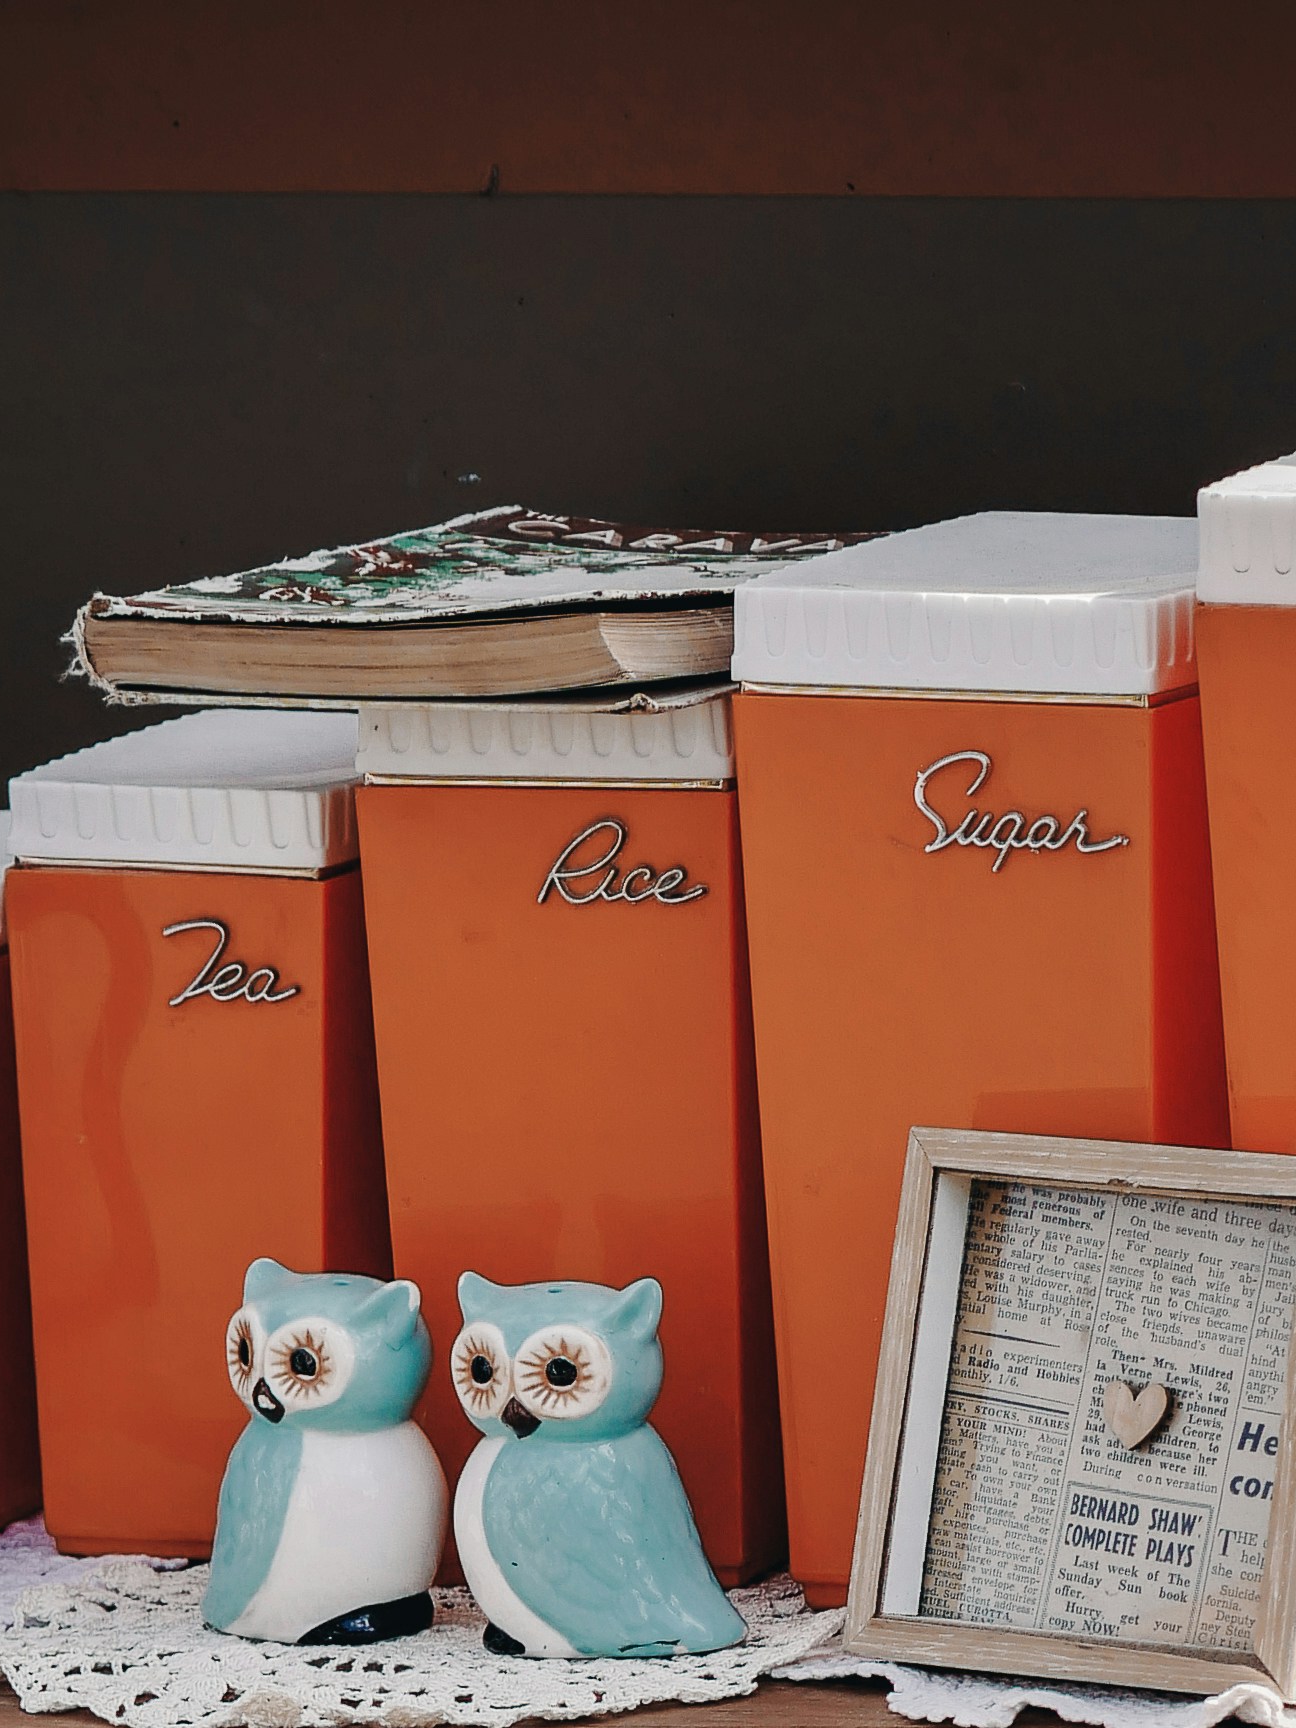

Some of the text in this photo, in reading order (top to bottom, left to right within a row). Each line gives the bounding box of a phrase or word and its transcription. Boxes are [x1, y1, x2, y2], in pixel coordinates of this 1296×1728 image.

[912, 748, 1130, 873] Sugar
[536, 817, 710, 906] Rice
[161, 918, 301, 1009] Tea
[991, 1204, 1034, 1220] Federal
[1031, 1200, 1081, 1216] generous
[1093, 1210, 1106, 1220] of
[1057, 1192, 1106, 1209] probably
[1121, 1191, 1149, 1210] one
[1190, 1207, 1218, 1223] and
[1225, 1210, 1262, 1230] three
[984, 1231, 1016, 1245] whole
[1022, 1238, 1035, 1248] of
[1040, 1240, 1058, 1253] his
[1044, 1231, 1072, 1242] gave
[1075, 1236, 1106, 1250] away
[1130, 1215, 1265, 1249] On the seventh day he
[1126, 1239, 1261, 1273] For nearly four years
[1272, 1241, 1290, 1254] the
[1010, 1249, 1102, 1273] salary to cases
[1111, 1249, 1125, 1262] he
[1139, 1257, 1194, 1274] explained
[1208, 1266, 1225, 1279] his
[984, 1269, 1005, 1281] was
[1075, 1286, 1097, 1297] and
[1109, 1264, 1256, 1298] sences to each wife by
[1267, 1267, 1292, 1280] man
[985, 1281, 1009, 1294] with
[1017, 1285, 1034, 1298] his
[1105, 1286, 1135, 1301] truck
[1140, 1295, 1160, 1306] run
[1167, 1297, 1178, 1308] to
[1149, 1281, 1163, 1294] he
[1170, 1287, 1191, 1298] was
[1197, 1292, 1240, 1308] making
[976, 1290, 1012, 1307] Louise
[1070, 1307, 1081, 1319] in
[997, 1307, 1028, 1322] home
[1040, 1316, 1051, 1326] at
[1115, 1299, 1249, 1334] The two wives became
[1259, 1301, 1285, 1317] jury
[1100, 1310, 1127, 1325] close
[1197, 1329, 1246, 1346] unaware
[1257, 1315, 1271, 1326] of
[1097, 1324, 1110, 1334] of
[1121, 1326, 1139, 1340] the
[1218, 1344, 1244, 1358] dual
[967, 1356, 1000, 1371] Radio
[1007, 1365, 1029, 1376] and
[1121, 1363, 1152, 1379] Verne
[1152, 1357, 1177, 1371] Mrs.
[1189, 1363, 1234, 1381] Mildred
[1250, 1353, 1277, 1369] hind
[1208, 1392, 1229, 1405] two
[1246, 1381, 1279, 1395] angry
[1027, 1415, 1070, 1431] SHARES
[1182, 1425, 1222, 1442] George
[1085, 1420, 1219, 1454] had to
[1237, 1421, 1279, 1456] He
[1080, 1445, 1101, 1458] two
[1107, 1450, 1152, 1467] children
[1159, 1461, 1186, 1474] were
[1082, 1434, 1100, 1446] ask
[1198, 1453, 1218, 1466] her
[1082, 1461, 1122, 1480] During
[1070, 1493, 1140, 1526] BERNARD
[1064, 1523, 1195, 1568] COMPLETE PLAYS
[1073, 1555, 1191, 1588] Last week of The
[1211, 1562, 1233, 1579] she
[1057, 1568, 1188, 1603] Sunday Sun book
[1048, 1616, 1120, 1637] copy NOW!
[1120, 1614, 1140, 1626] get
[1153, 1621, 1183, 1633] your
